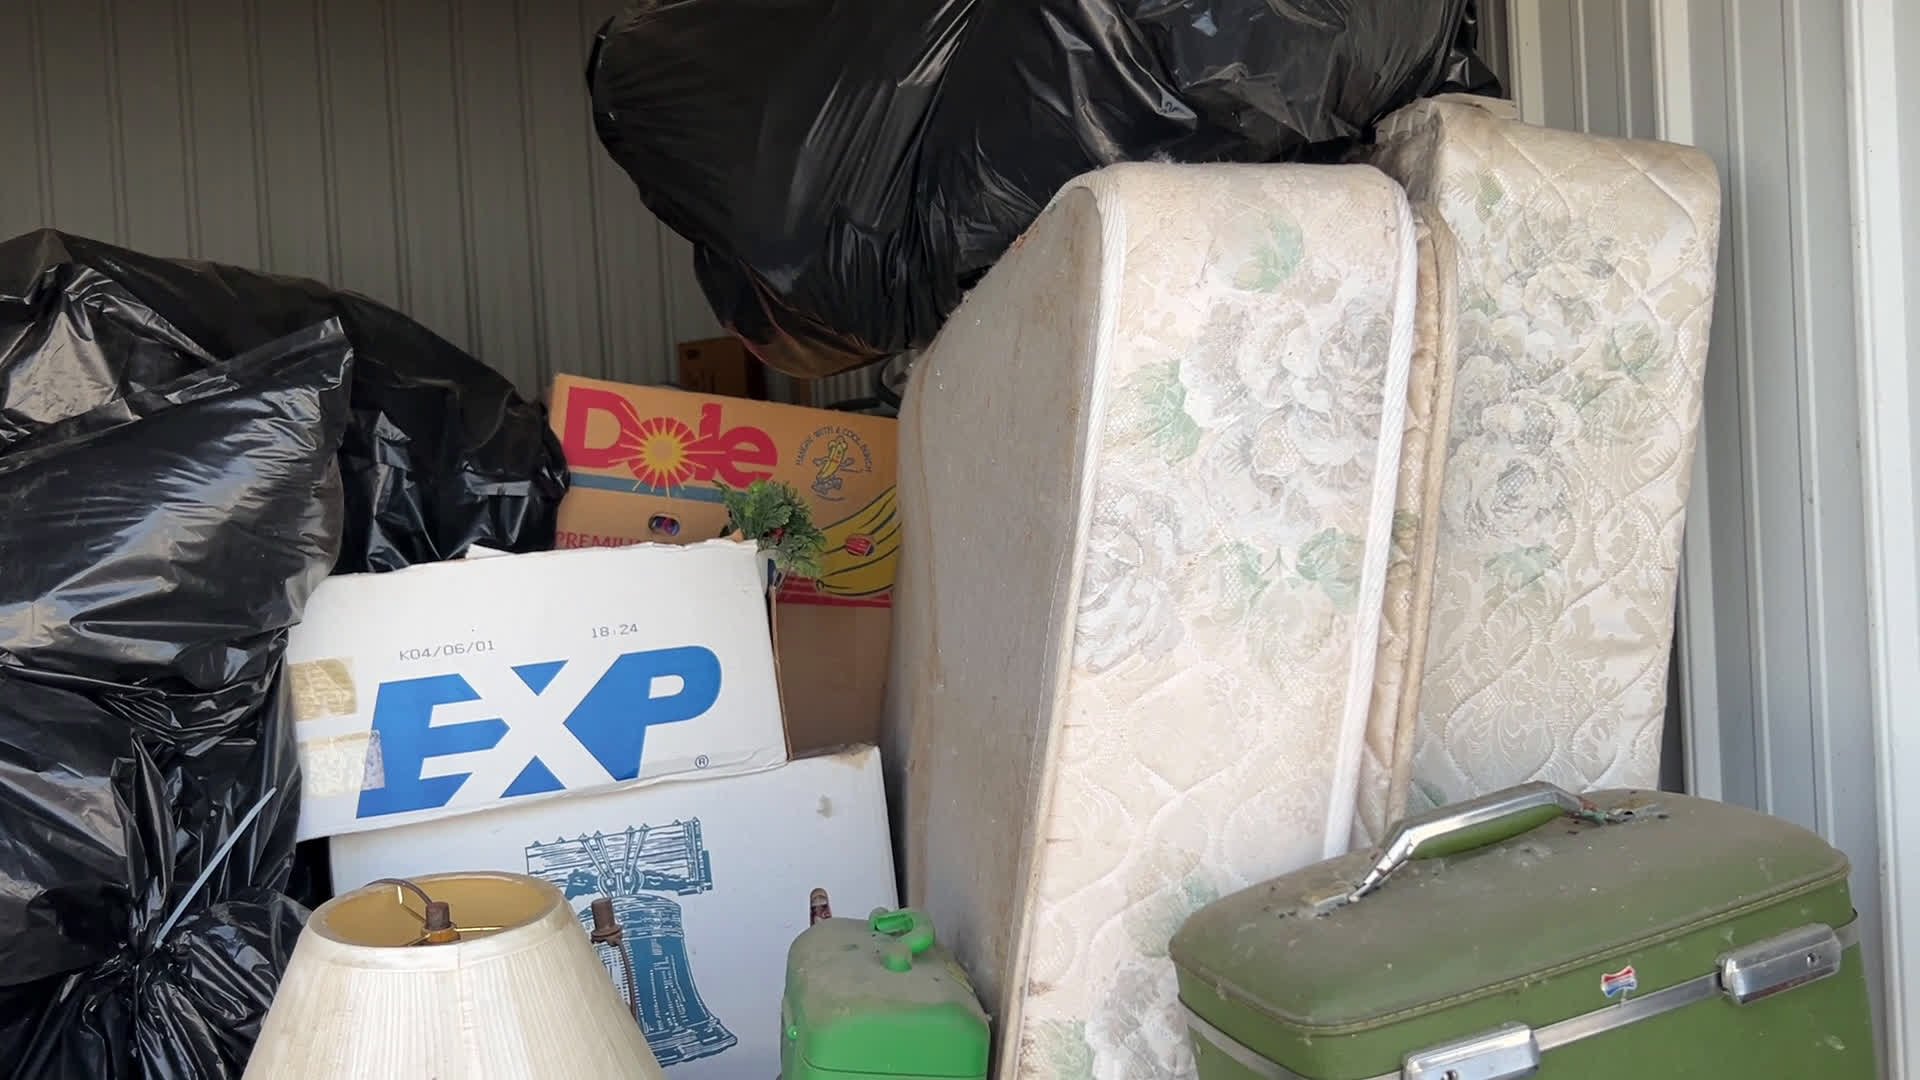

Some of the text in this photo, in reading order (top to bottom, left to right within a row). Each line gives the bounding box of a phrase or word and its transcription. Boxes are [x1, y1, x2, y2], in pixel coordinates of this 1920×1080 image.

[563, 386, 778, 489] Dole
[399, 640, 495, 661] K04/06/01
[356, 645, 722, 818] EXP
